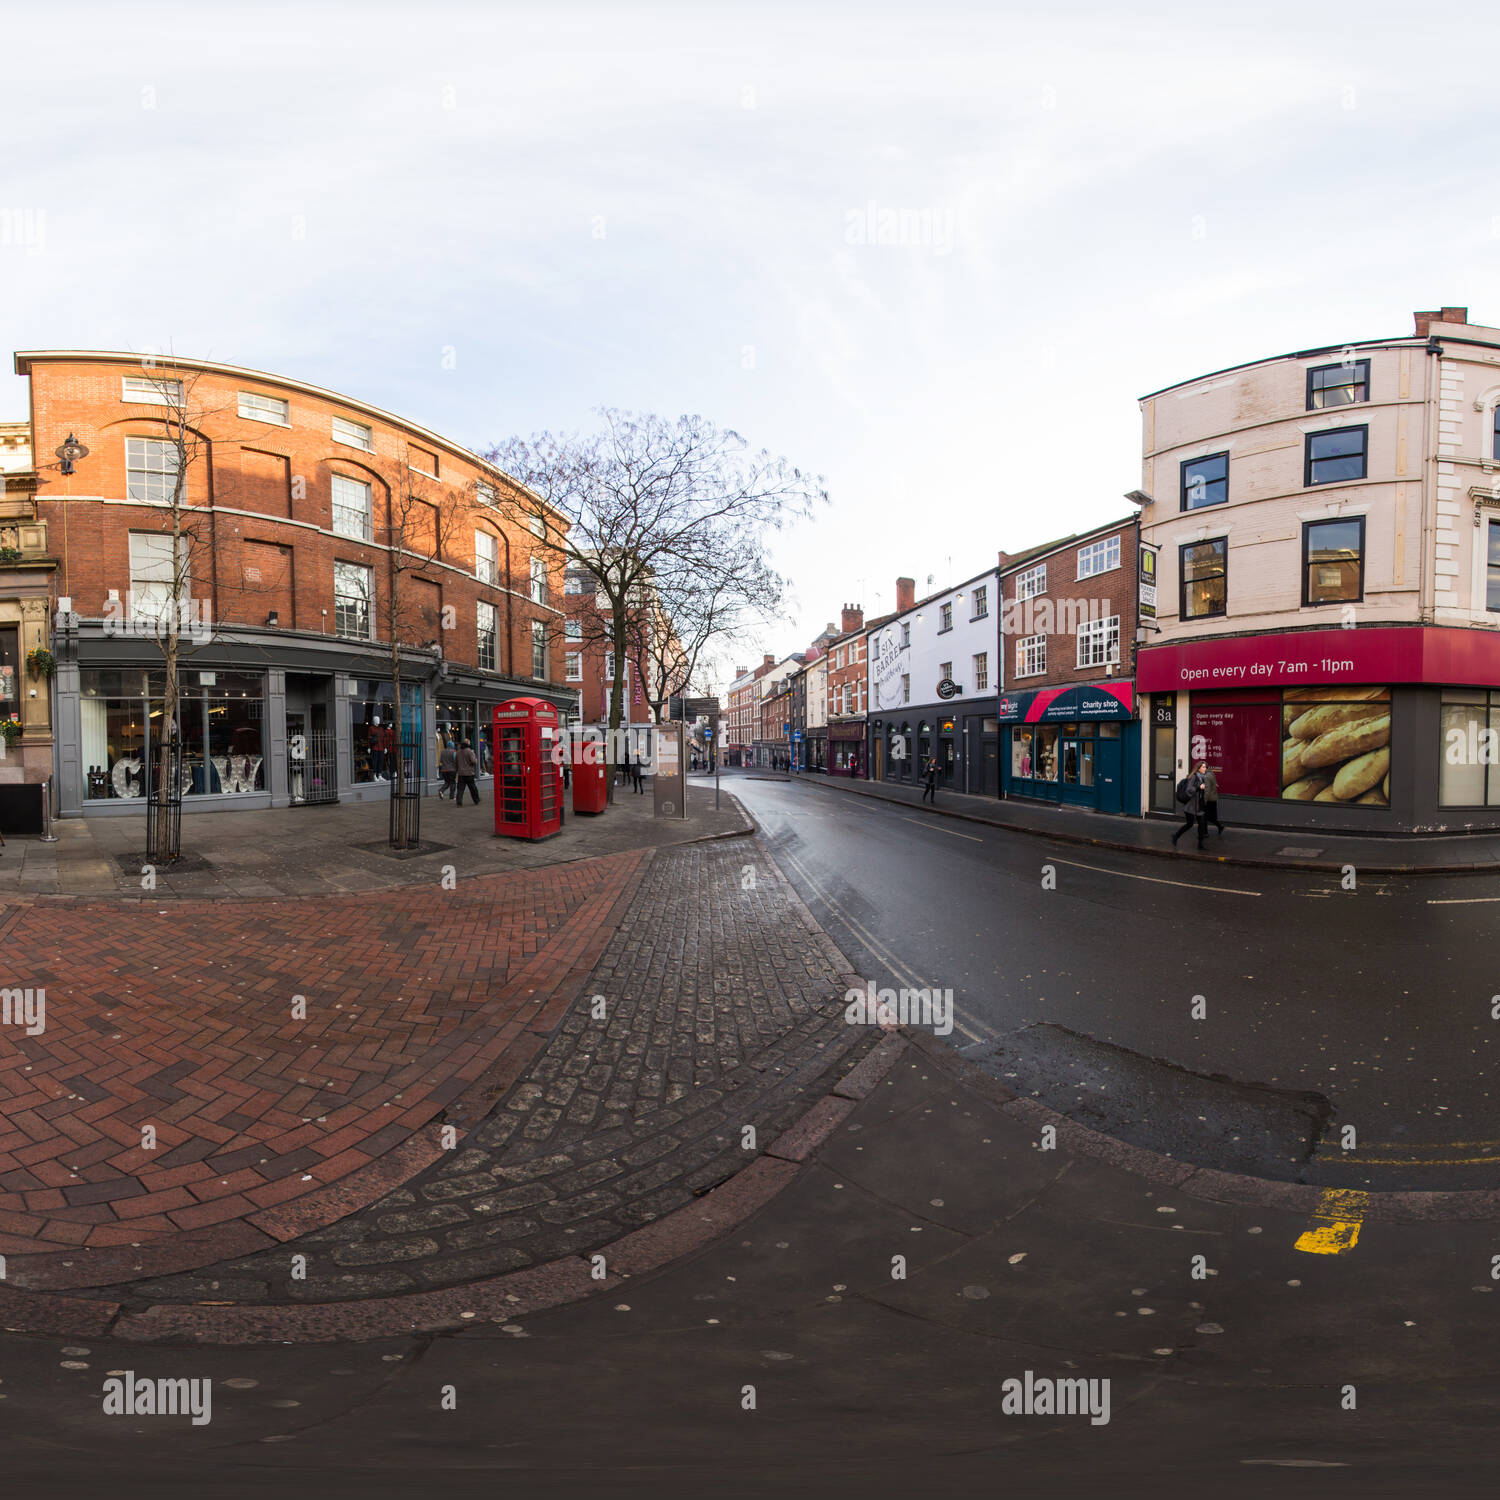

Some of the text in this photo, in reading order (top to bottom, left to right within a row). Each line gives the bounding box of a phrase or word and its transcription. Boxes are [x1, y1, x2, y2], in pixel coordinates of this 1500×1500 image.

[881, 635, 893, 655] SIX
[1181, 668, 1209, 681] Open
[1212, 665, 1246, 678] every
[1250, 662, 1274, 676] day
[1278, 661, 1308, 674] 7am
[1321, 658, 1354, 675] 11pm
[1082, 700, 1118, 709] Charity shop
[1157, 708, 1172, 721] 8a
